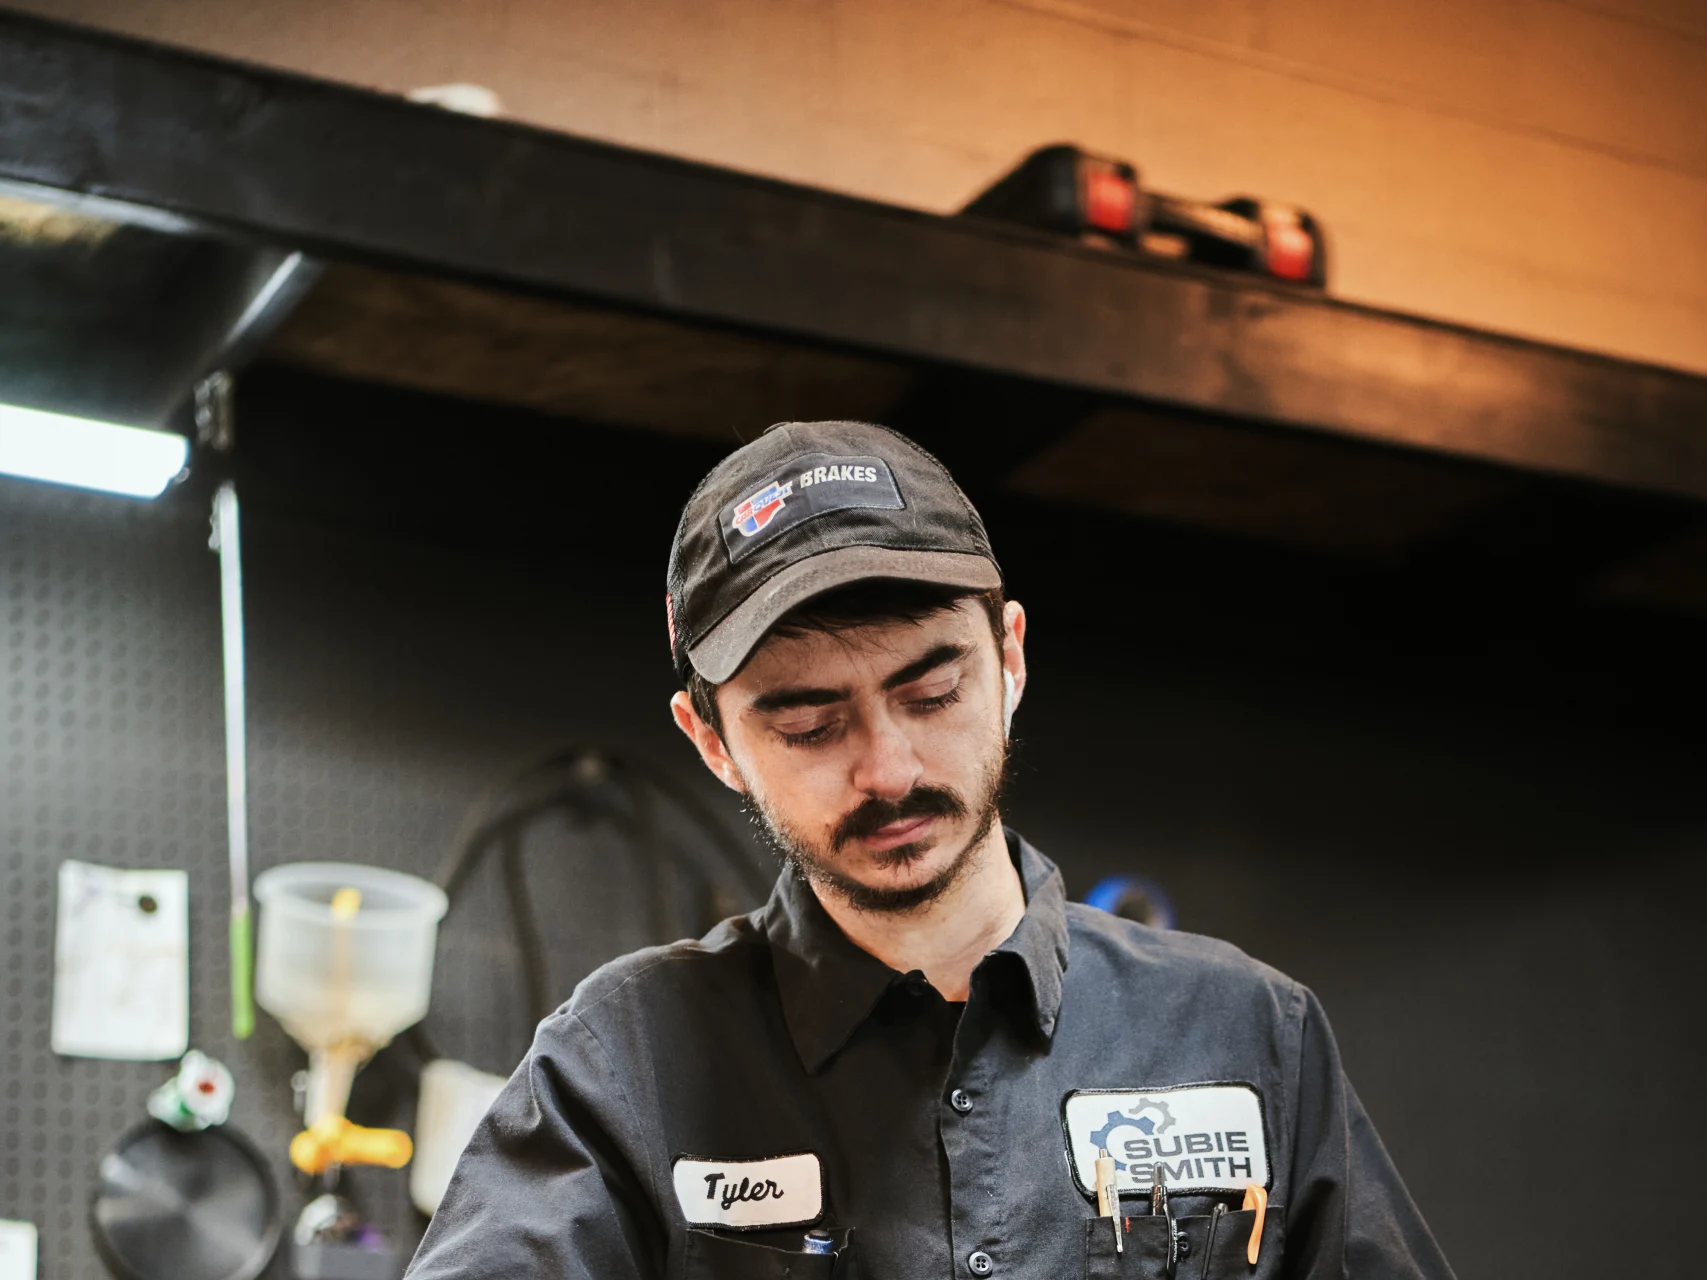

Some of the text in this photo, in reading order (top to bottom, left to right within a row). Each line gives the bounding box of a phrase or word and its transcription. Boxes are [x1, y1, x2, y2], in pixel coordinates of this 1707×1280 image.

[800, 465, 878, 489] BRAKES
[1123, 1131, 1250, 1160] SUBIE
[1129, 1157, 1252, 1184] SMITH
[703, 1172, 785, 1211] Tyler
